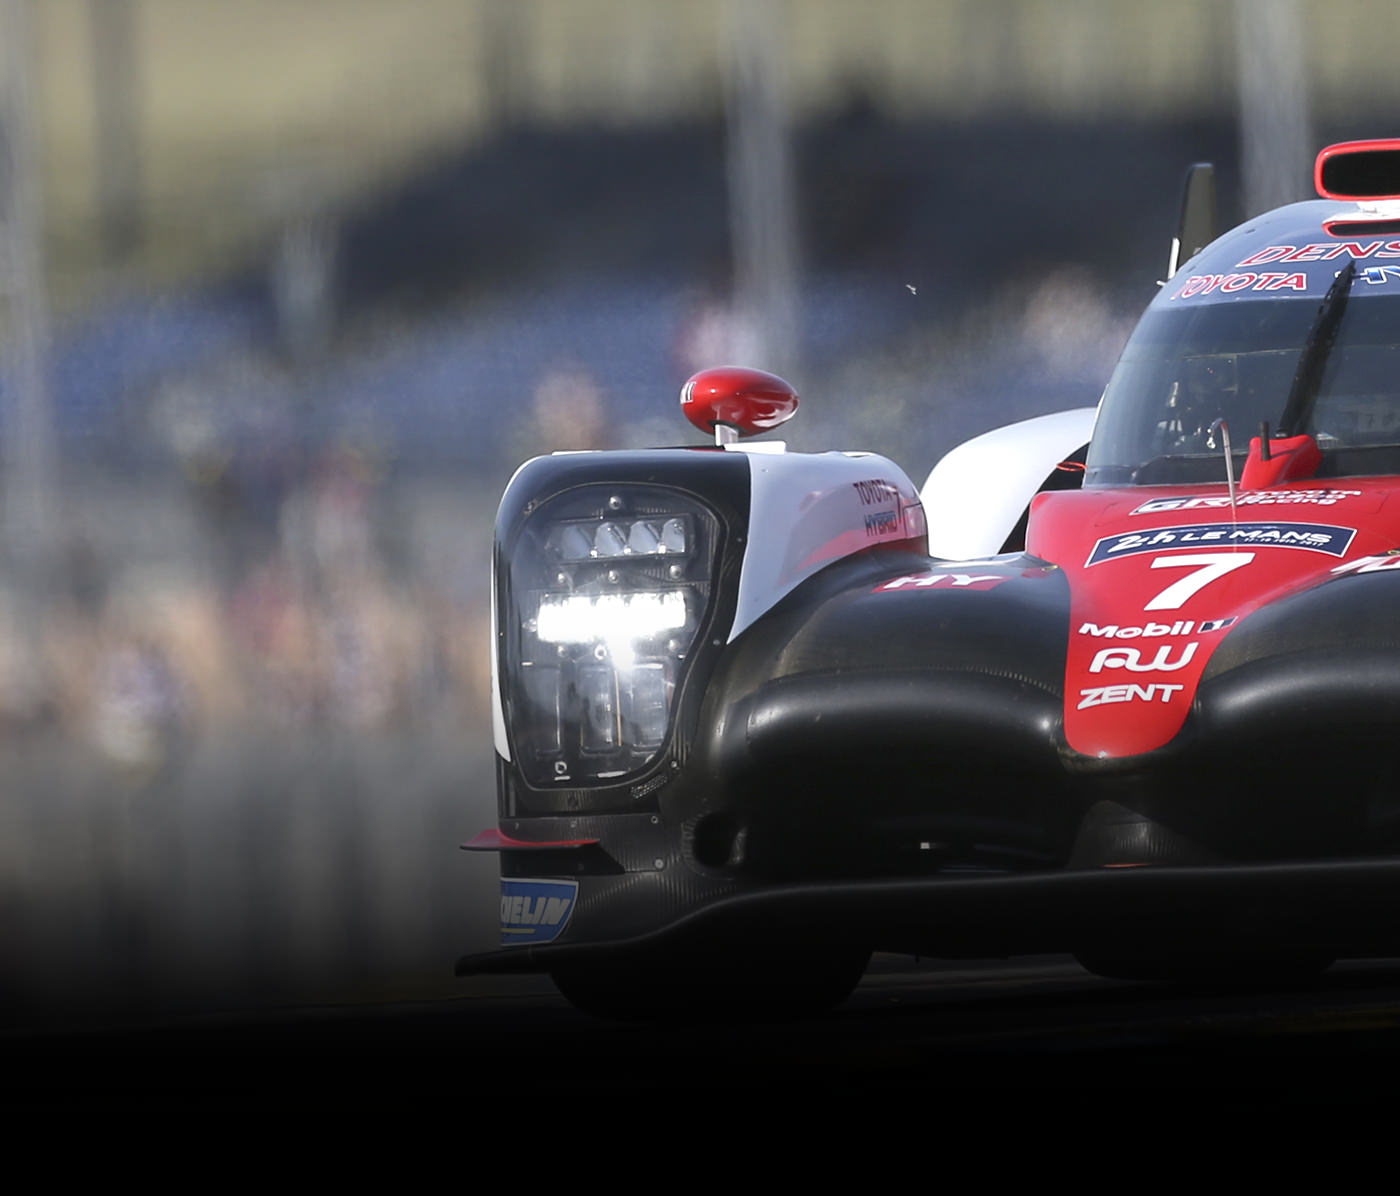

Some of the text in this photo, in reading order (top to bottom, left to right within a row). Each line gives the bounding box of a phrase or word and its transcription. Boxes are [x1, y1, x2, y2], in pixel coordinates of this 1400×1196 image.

[1169, 272, 1307, 300] TOYOTA
[1180, 531, 1227, 542] LE
[1228, 530, 1333, 544] MANS
[883, 574, 1005, 589] HY
[1143, 552, 1256, 611] 7
[1079, 621, 1195, 639] Mobil
[1077, 683, 1184, 710] ZENT
